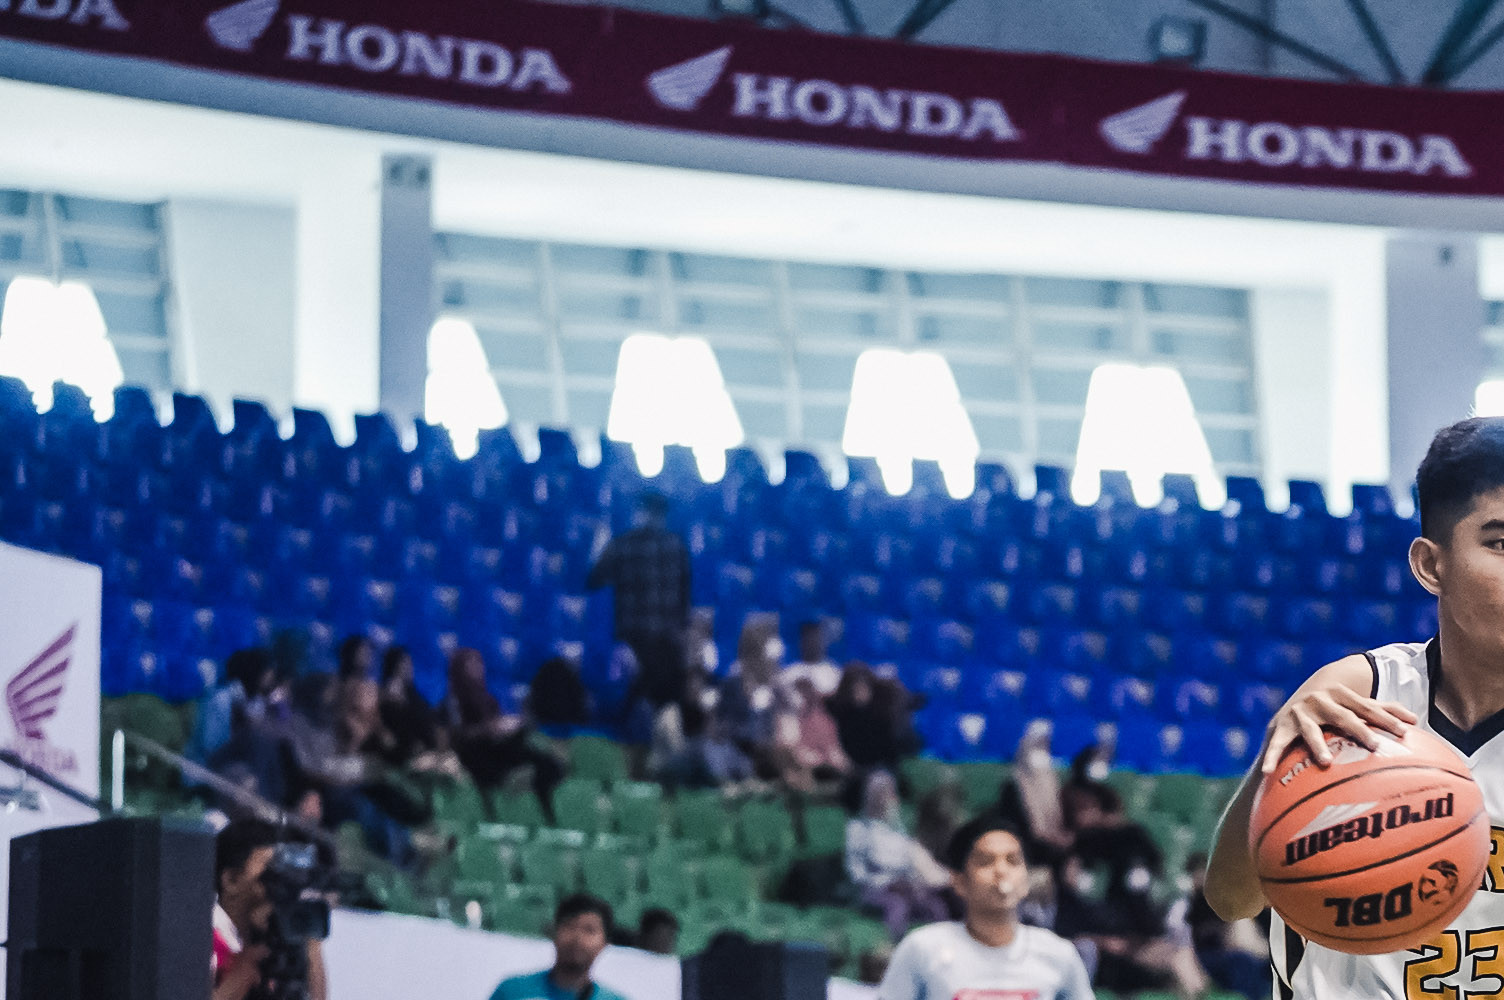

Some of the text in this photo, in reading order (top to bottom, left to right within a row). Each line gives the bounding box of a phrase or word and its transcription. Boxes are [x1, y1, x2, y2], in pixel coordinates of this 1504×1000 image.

[285, 13, 572, 95] HONDA
[730, 71, 1022, 142] HONDA
[1185, 116, 1475, 178] HONDA
[1283, 792, 1455, 866] proteam
[1324, 882, 1414, 927] DBL
